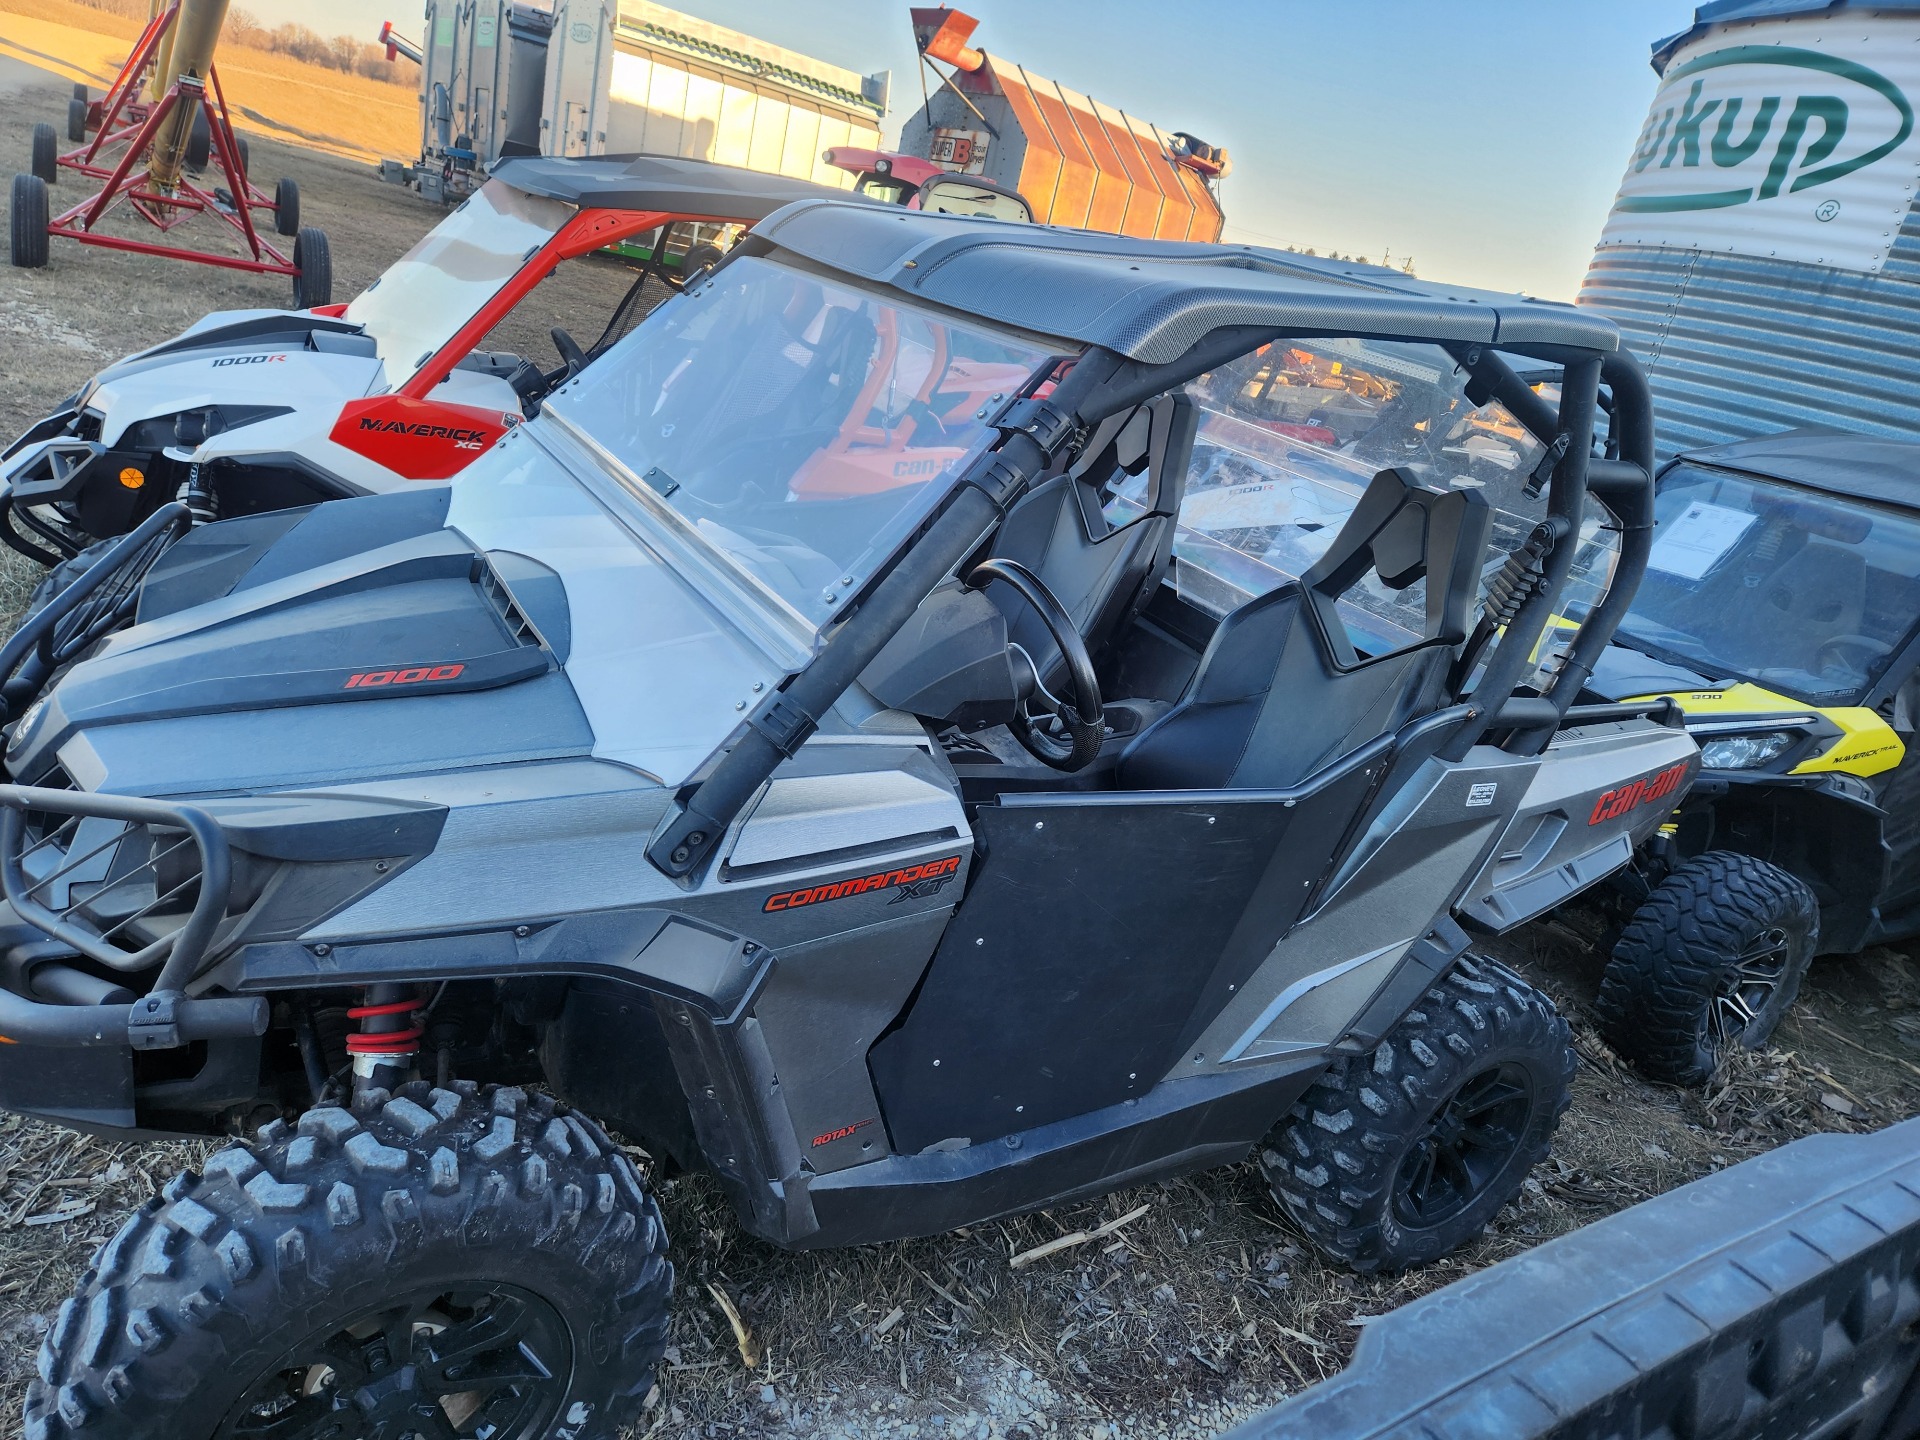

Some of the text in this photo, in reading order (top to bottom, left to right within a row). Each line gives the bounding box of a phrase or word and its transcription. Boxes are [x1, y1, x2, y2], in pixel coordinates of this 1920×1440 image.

[952, 138, 971, 164] B
[212, 355, 287, 368] 1000R
[359, 418, 487, 443] MAVERICK
[454, 440, 483, 450] XC
[344, 664, 464, 688] 1000
[1833, 749, 1880, 764] MAVERICK
[1588, 762, 1689, 826] can-am
[764, 856, 961, 912] COMMANDER
[888, 875, 954, 905] XT
[812, 1125, 856, 1147] ROTAX
